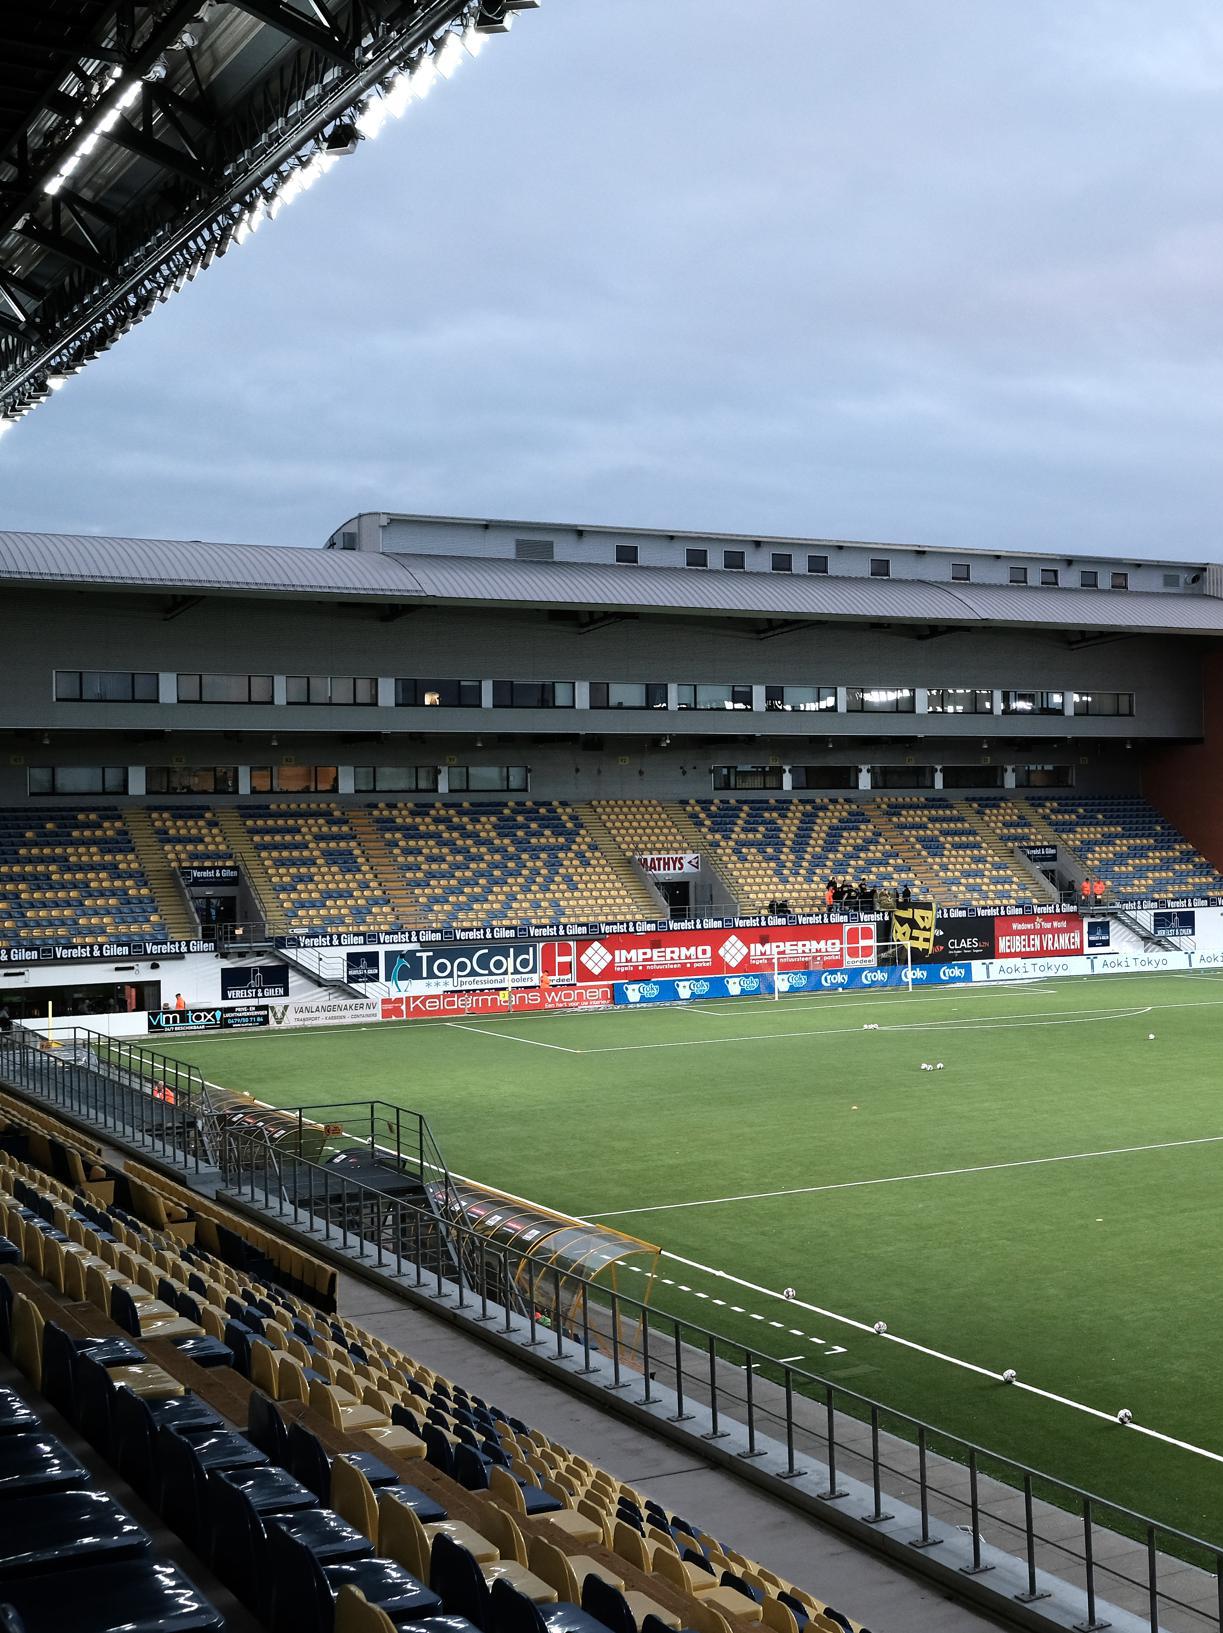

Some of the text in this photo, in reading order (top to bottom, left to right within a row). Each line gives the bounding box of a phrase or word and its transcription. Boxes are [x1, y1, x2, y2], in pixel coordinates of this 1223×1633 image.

[640, 856, 684, 872] MATHYS
[977, 906, 998, 918] Verelst
[1006, 904, 1023, 915] Gilen
[1033, 904, 1055, 915] Verelst
[1062, 903, 1078, 912] Gilen
[1166, 899, 1187, 909] Verelst
[949, 908, 967, 918] Gilen
[333, 935, 339, 946] &
[341, 933, 364, 945] Gilen
[379, 931, 410, 943] Verelst
[411, 931, 418, 942] &
[419, 930, 441, 942] Gilen
[455, 928, 485, 940] Verelst
[487, 928, 493, 939] &
[495, 927, 516, 939] Gilen
[529, 926, 557, 938] Verelst
[559, 926, 565, 936] &
[566, 925, 587, 935] Gilen
[600, 922, 627, 934] Verelst
[629, 922, 635, 932] &
[637, 921, 656, 932] Gilen
[669, 920, 695, 932] Verelst
[697, 920, 702, 930] &
[703, 918, 722, 929] Gilen
[735, 918, 760, 930] Verelst
[761, 917, 767, 927] &
[768, 916, 787, 927] Gilen
[798, 914, 823, 926] Verelst
[824, 913, 830, 924] &
[831, 912, 849, 923] Gilen
[860, 911, 883, 923] Verelst
[1012, 923, 1034, 933] Windows
[1053, 920, 1067, 929] World
[749, 939, 842, 957] IMPERMO
[948, 938, 979, 949] CLAES
[998, 931, 1081, 953] MEUBELEN VRANKEN
[11, 948, 38, 960] Gilen
[56, 945, 91, 959] Verelst
[93, 946, 101, 957] &
[103, 944, 129, 957] Gilen
[146, 942, 179, 954] Verelst
[180, 942, 187, 953] &
[189, 941, 215, 953] Gilen
[614, 945, 712, 963] IMPERMO
[416, 947, 534, 987] TopCold
[846, 957, 875, 967] cordeel
[787, 973, 807, 983] Croky
[821, 971, 849, 986] Croky
[862, 969, 889, 985] Croky
[901, 968, 928, 981] Croky
[940, 965, 965, 980] Croky
[460, 974, 533, 989] professional oolers
[549, 976, 573, 984] rdeel
[689, 979, 710, 991] Croky
[740, 976, 760, 987] Croky
[227, 988, 284, 1000] VERELST & GILEN
[638, 982, 660, 994] Croky
[409, 991, 540, 1011] Keldermans
[544, 986, 611, 1004] wonen
[294, 1002, 377, 1014] VANLANGENAKER NV
